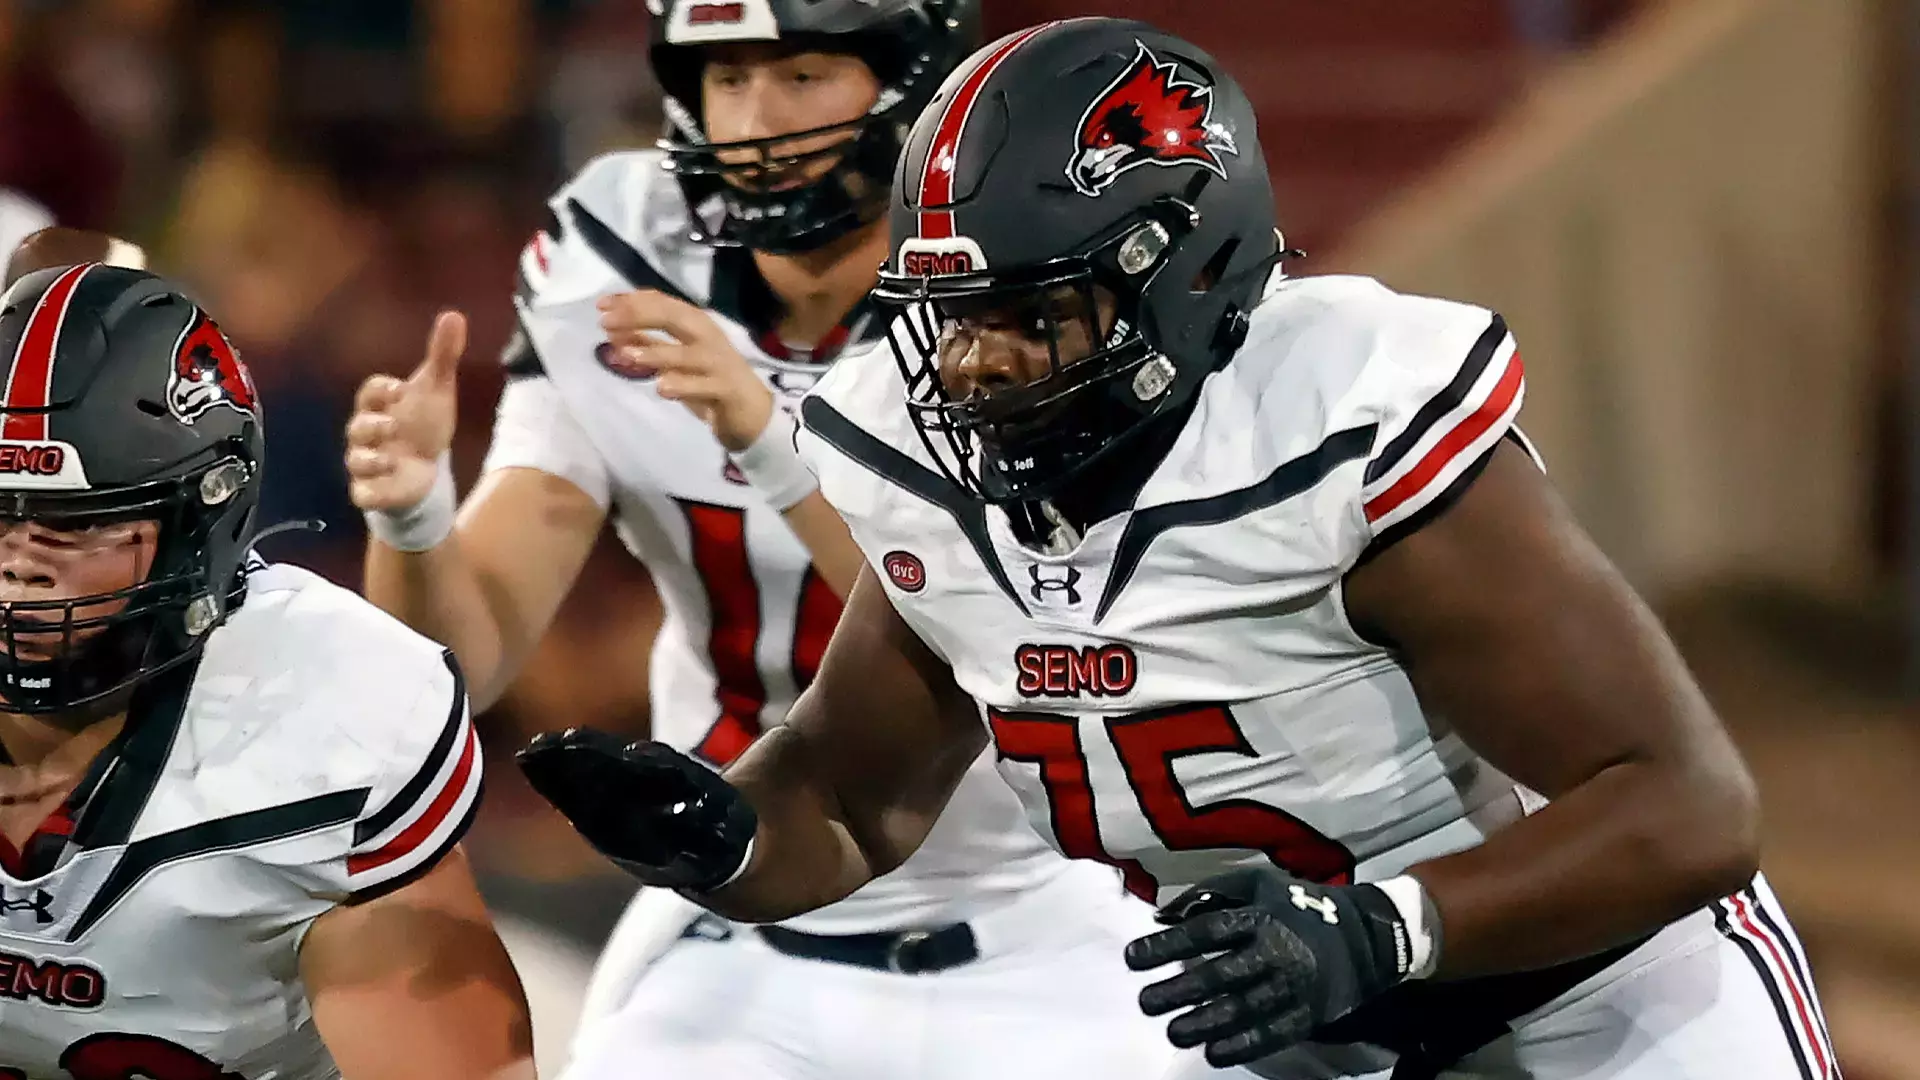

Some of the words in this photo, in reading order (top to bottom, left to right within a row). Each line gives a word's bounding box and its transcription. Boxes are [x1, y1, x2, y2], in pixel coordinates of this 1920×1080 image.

[904, 251, 972, 276] SEMO
[0, 445, 64, 475] EMO
[1015, 643, 1137, 698] SEMO
[987, 702, 1356, 908] 75
[0, 953, 106, 1008] EMO
